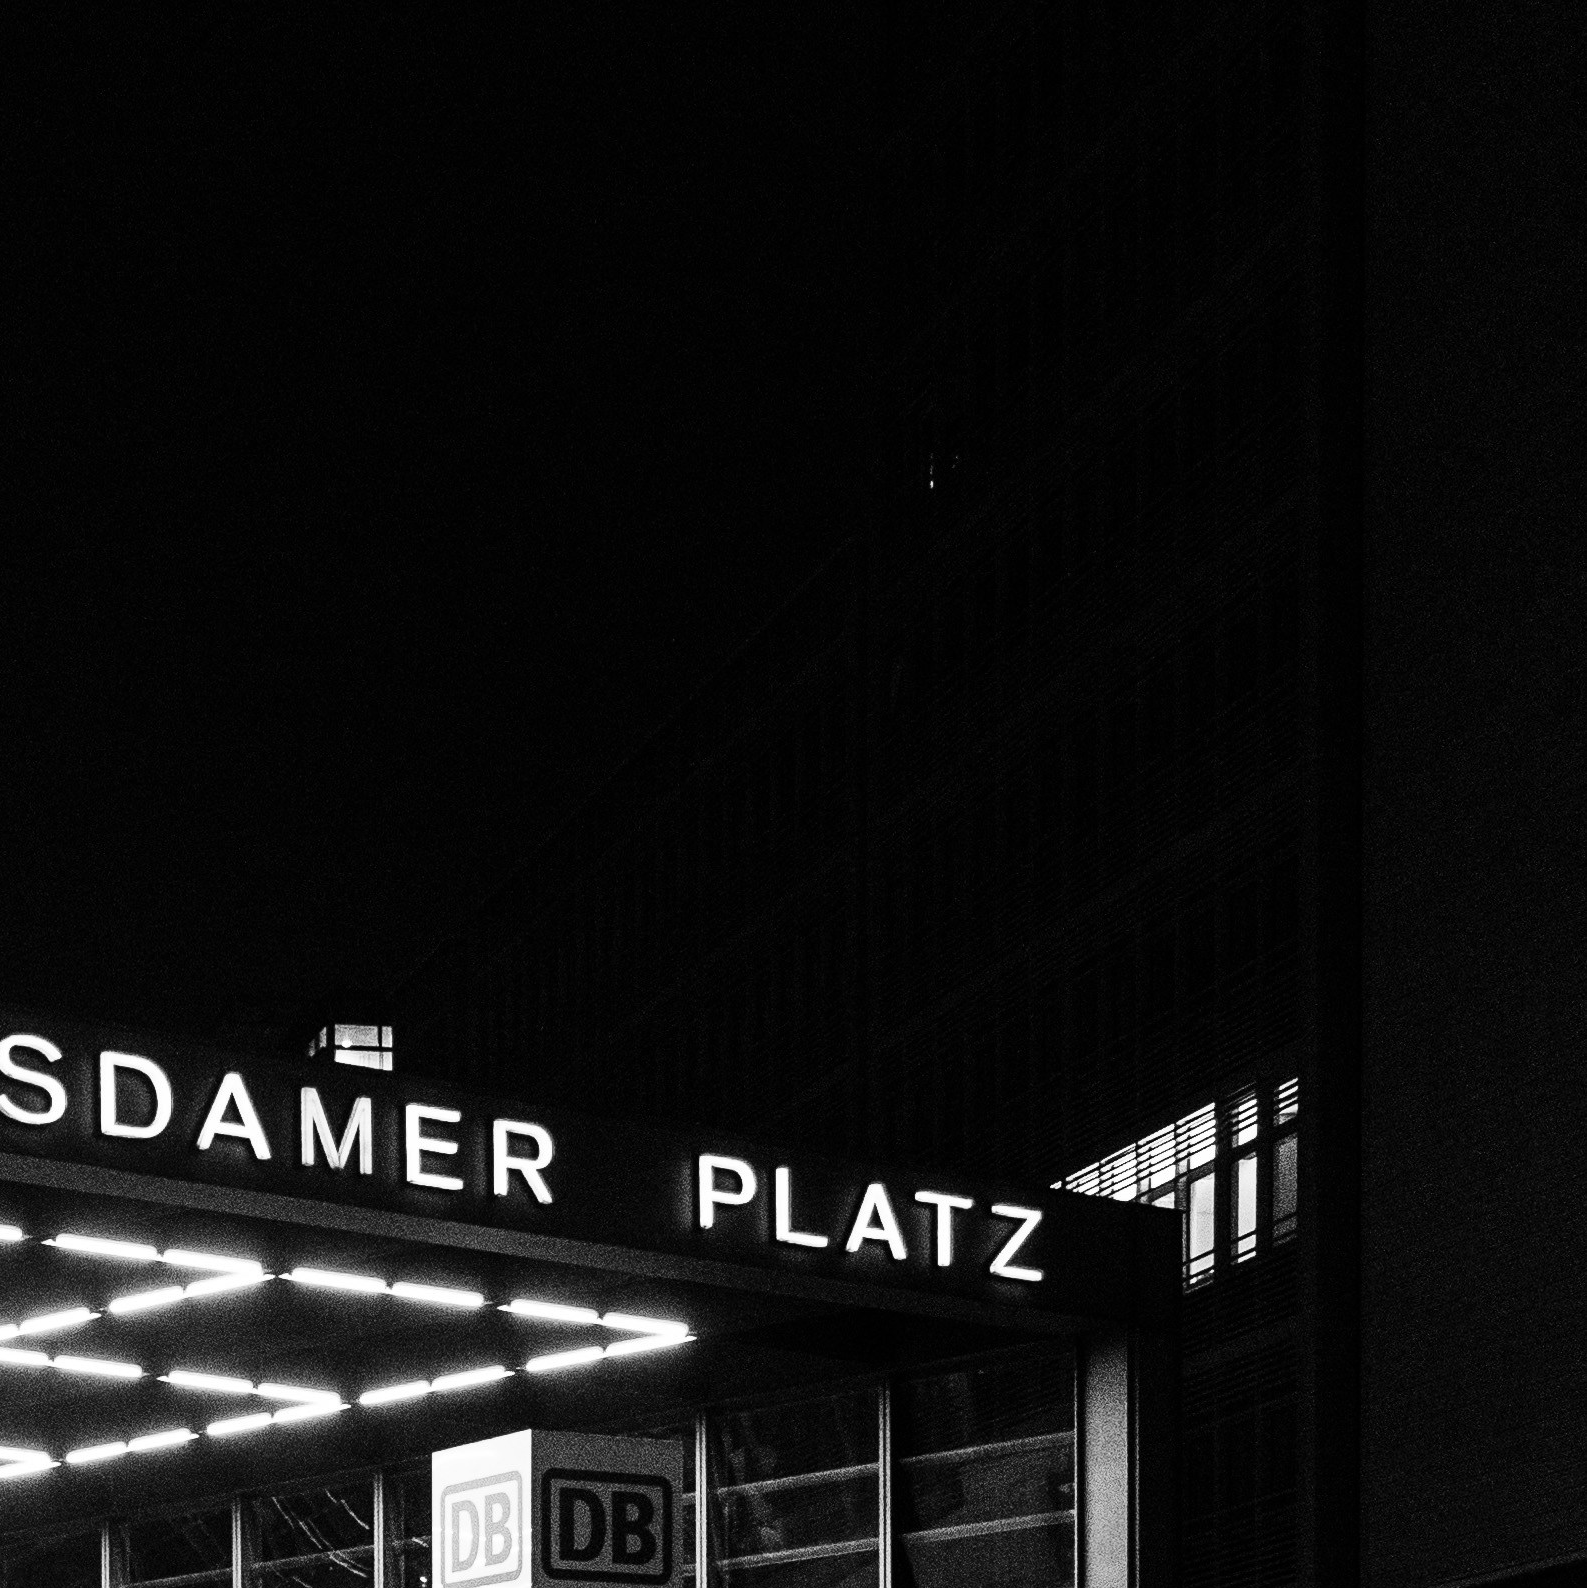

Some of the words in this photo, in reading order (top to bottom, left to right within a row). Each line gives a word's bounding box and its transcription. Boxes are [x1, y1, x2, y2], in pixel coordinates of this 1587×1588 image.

[697, 1153, 1044, 1283] PLATZ
[450, 1490, 513, 1573] DB
[558, 1487, 656, 1566] DB
